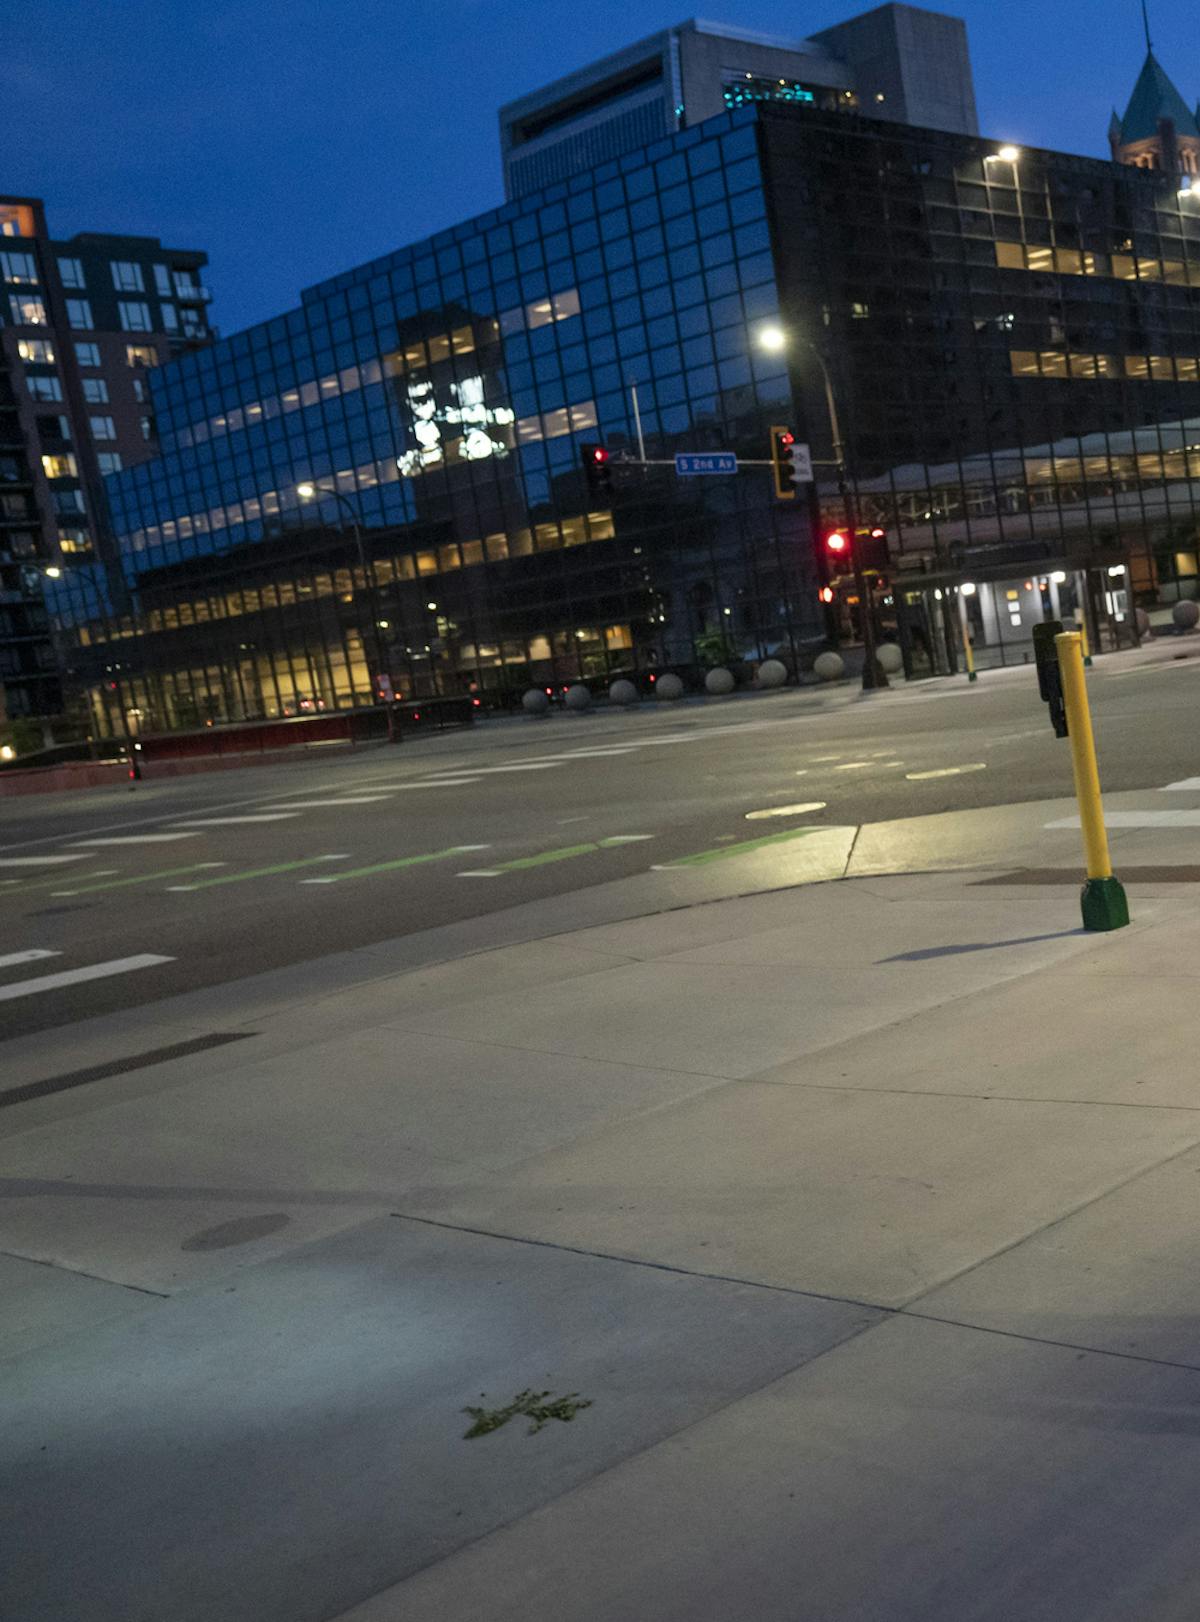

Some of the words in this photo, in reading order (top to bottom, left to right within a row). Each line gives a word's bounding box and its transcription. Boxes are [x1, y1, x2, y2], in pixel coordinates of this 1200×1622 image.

[681, 459, 688, 470] S
[693, 458, 714, 470] 2nd
[720, 458, 732, 469] Av
